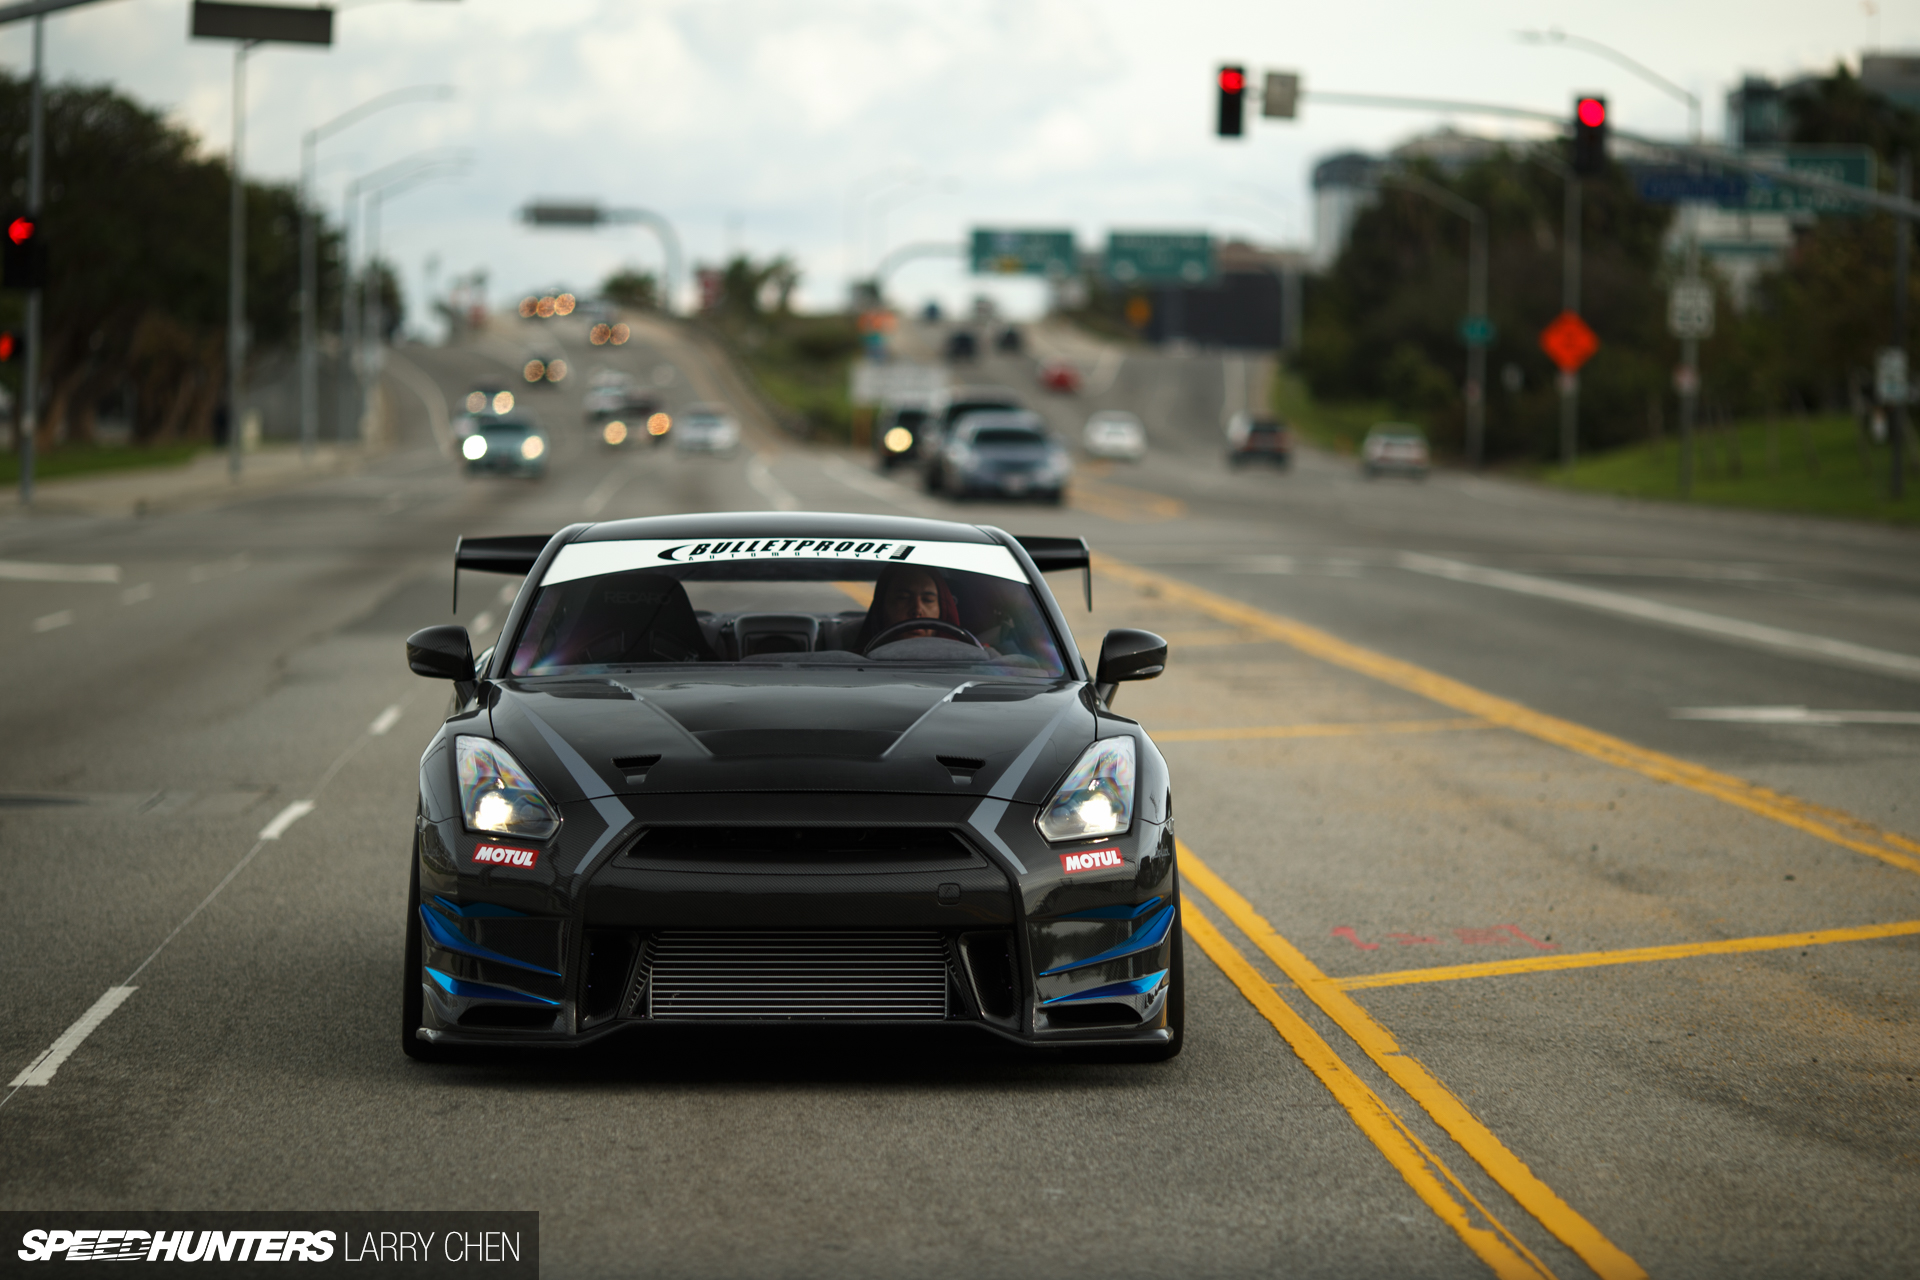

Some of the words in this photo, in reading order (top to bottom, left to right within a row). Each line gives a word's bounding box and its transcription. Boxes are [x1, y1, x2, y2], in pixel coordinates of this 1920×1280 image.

[688, 539, 893, 556] BULLETPROOF
[604, 591, 672, 605] RECARO
[475, 846, 533, 867] MOTUL
[1065, 850, 1121, 871] MOTUL
